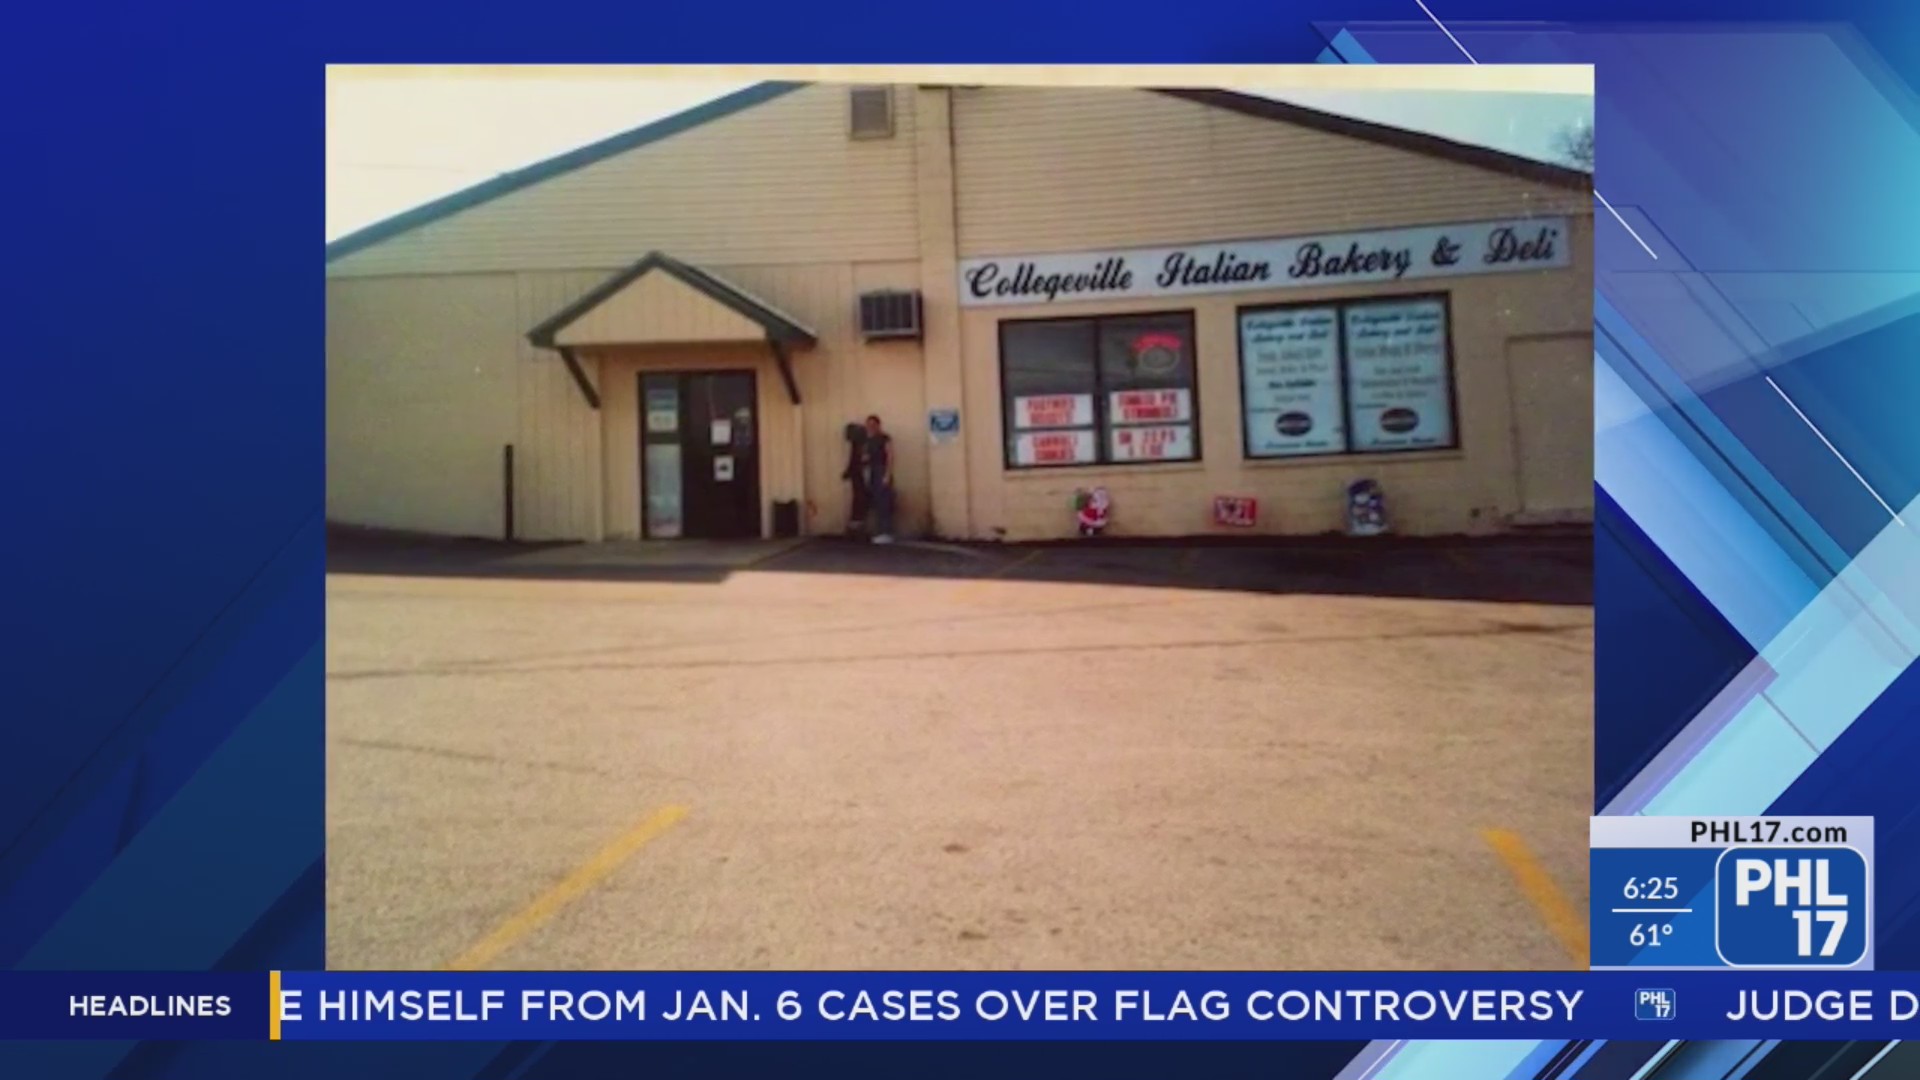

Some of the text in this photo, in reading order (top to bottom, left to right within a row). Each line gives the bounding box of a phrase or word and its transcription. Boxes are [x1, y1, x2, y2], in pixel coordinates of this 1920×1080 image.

[966, 226, 1558, 301] Collegeville Italian Bakery & Deli
